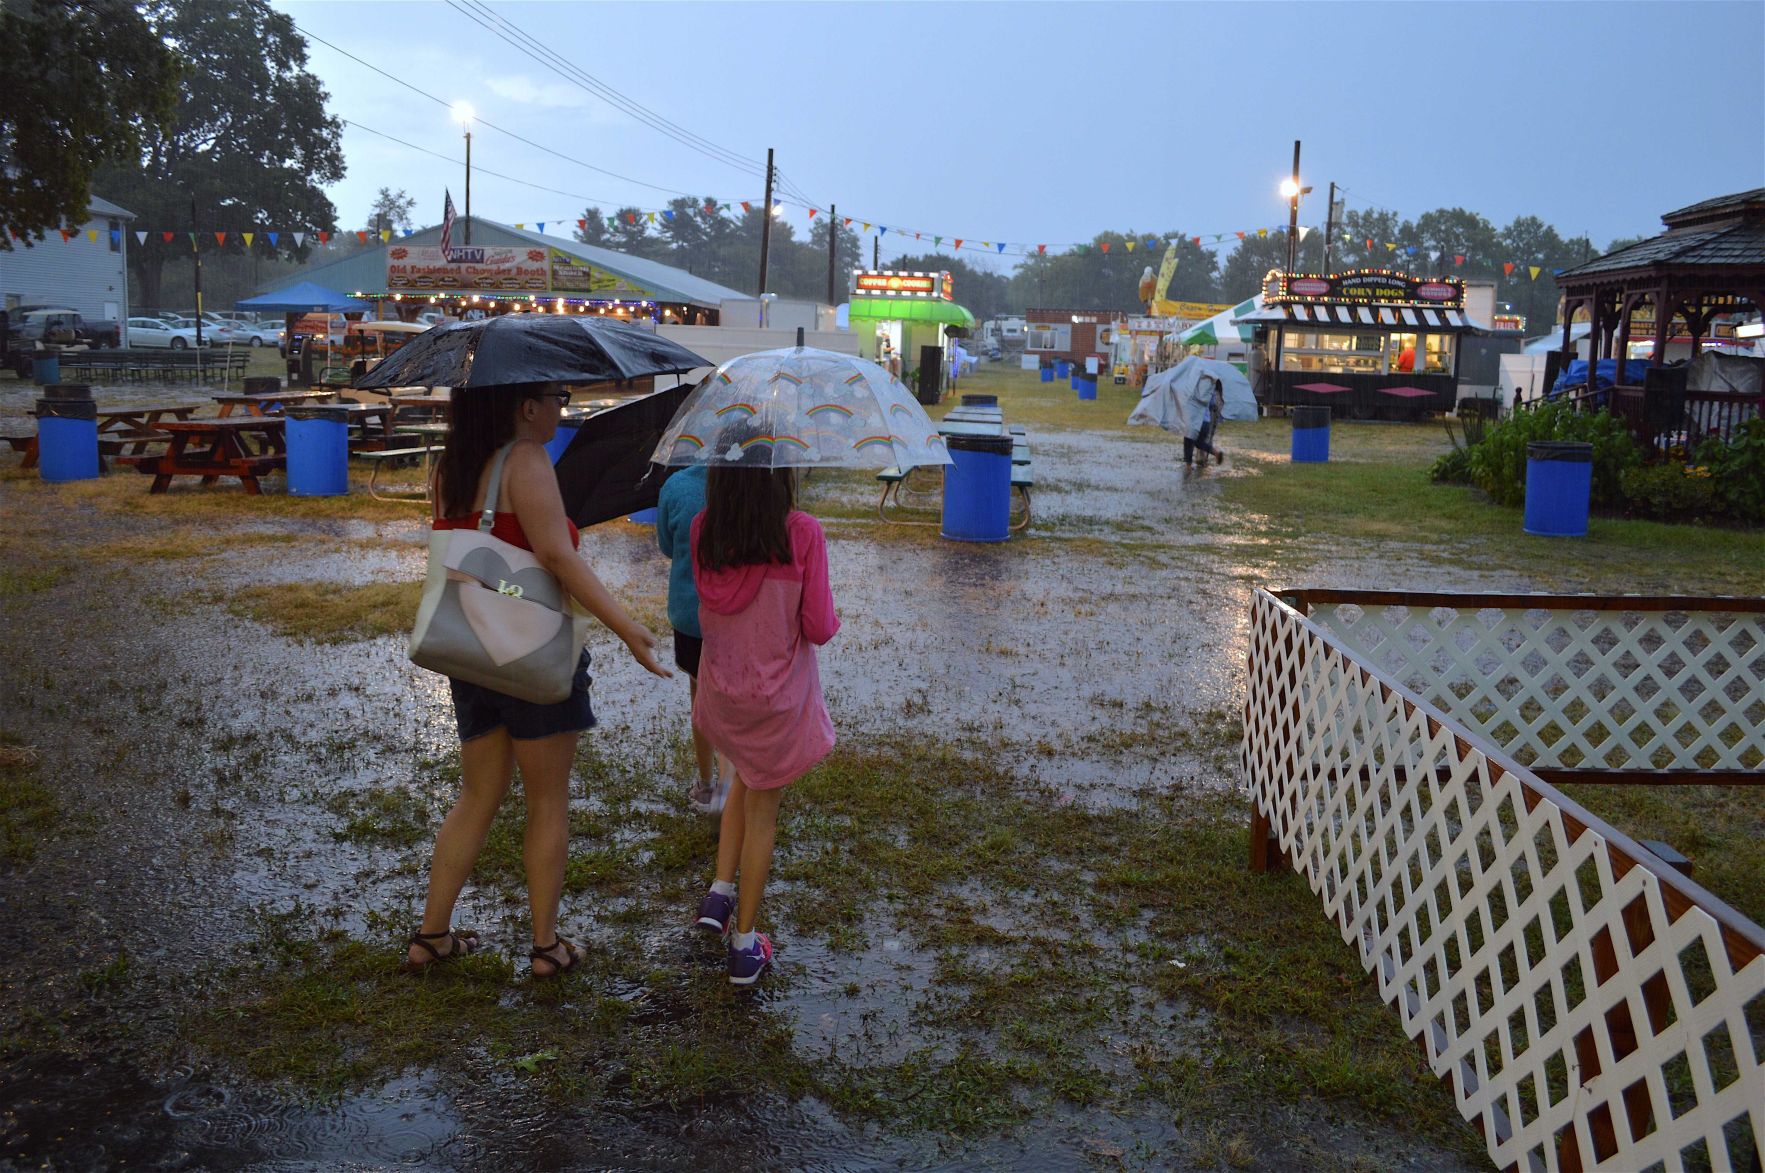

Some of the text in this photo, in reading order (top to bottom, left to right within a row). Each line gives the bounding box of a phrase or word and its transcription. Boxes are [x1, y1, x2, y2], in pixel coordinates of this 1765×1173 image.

[390, 264, 547, 276] Old Fashioned Chowder Booth
[1342, 277, 1361, 286] HAND
[1388, 278, 1406, 288] LONG
[1342, 287, 1405, 297] CORN DOGS
